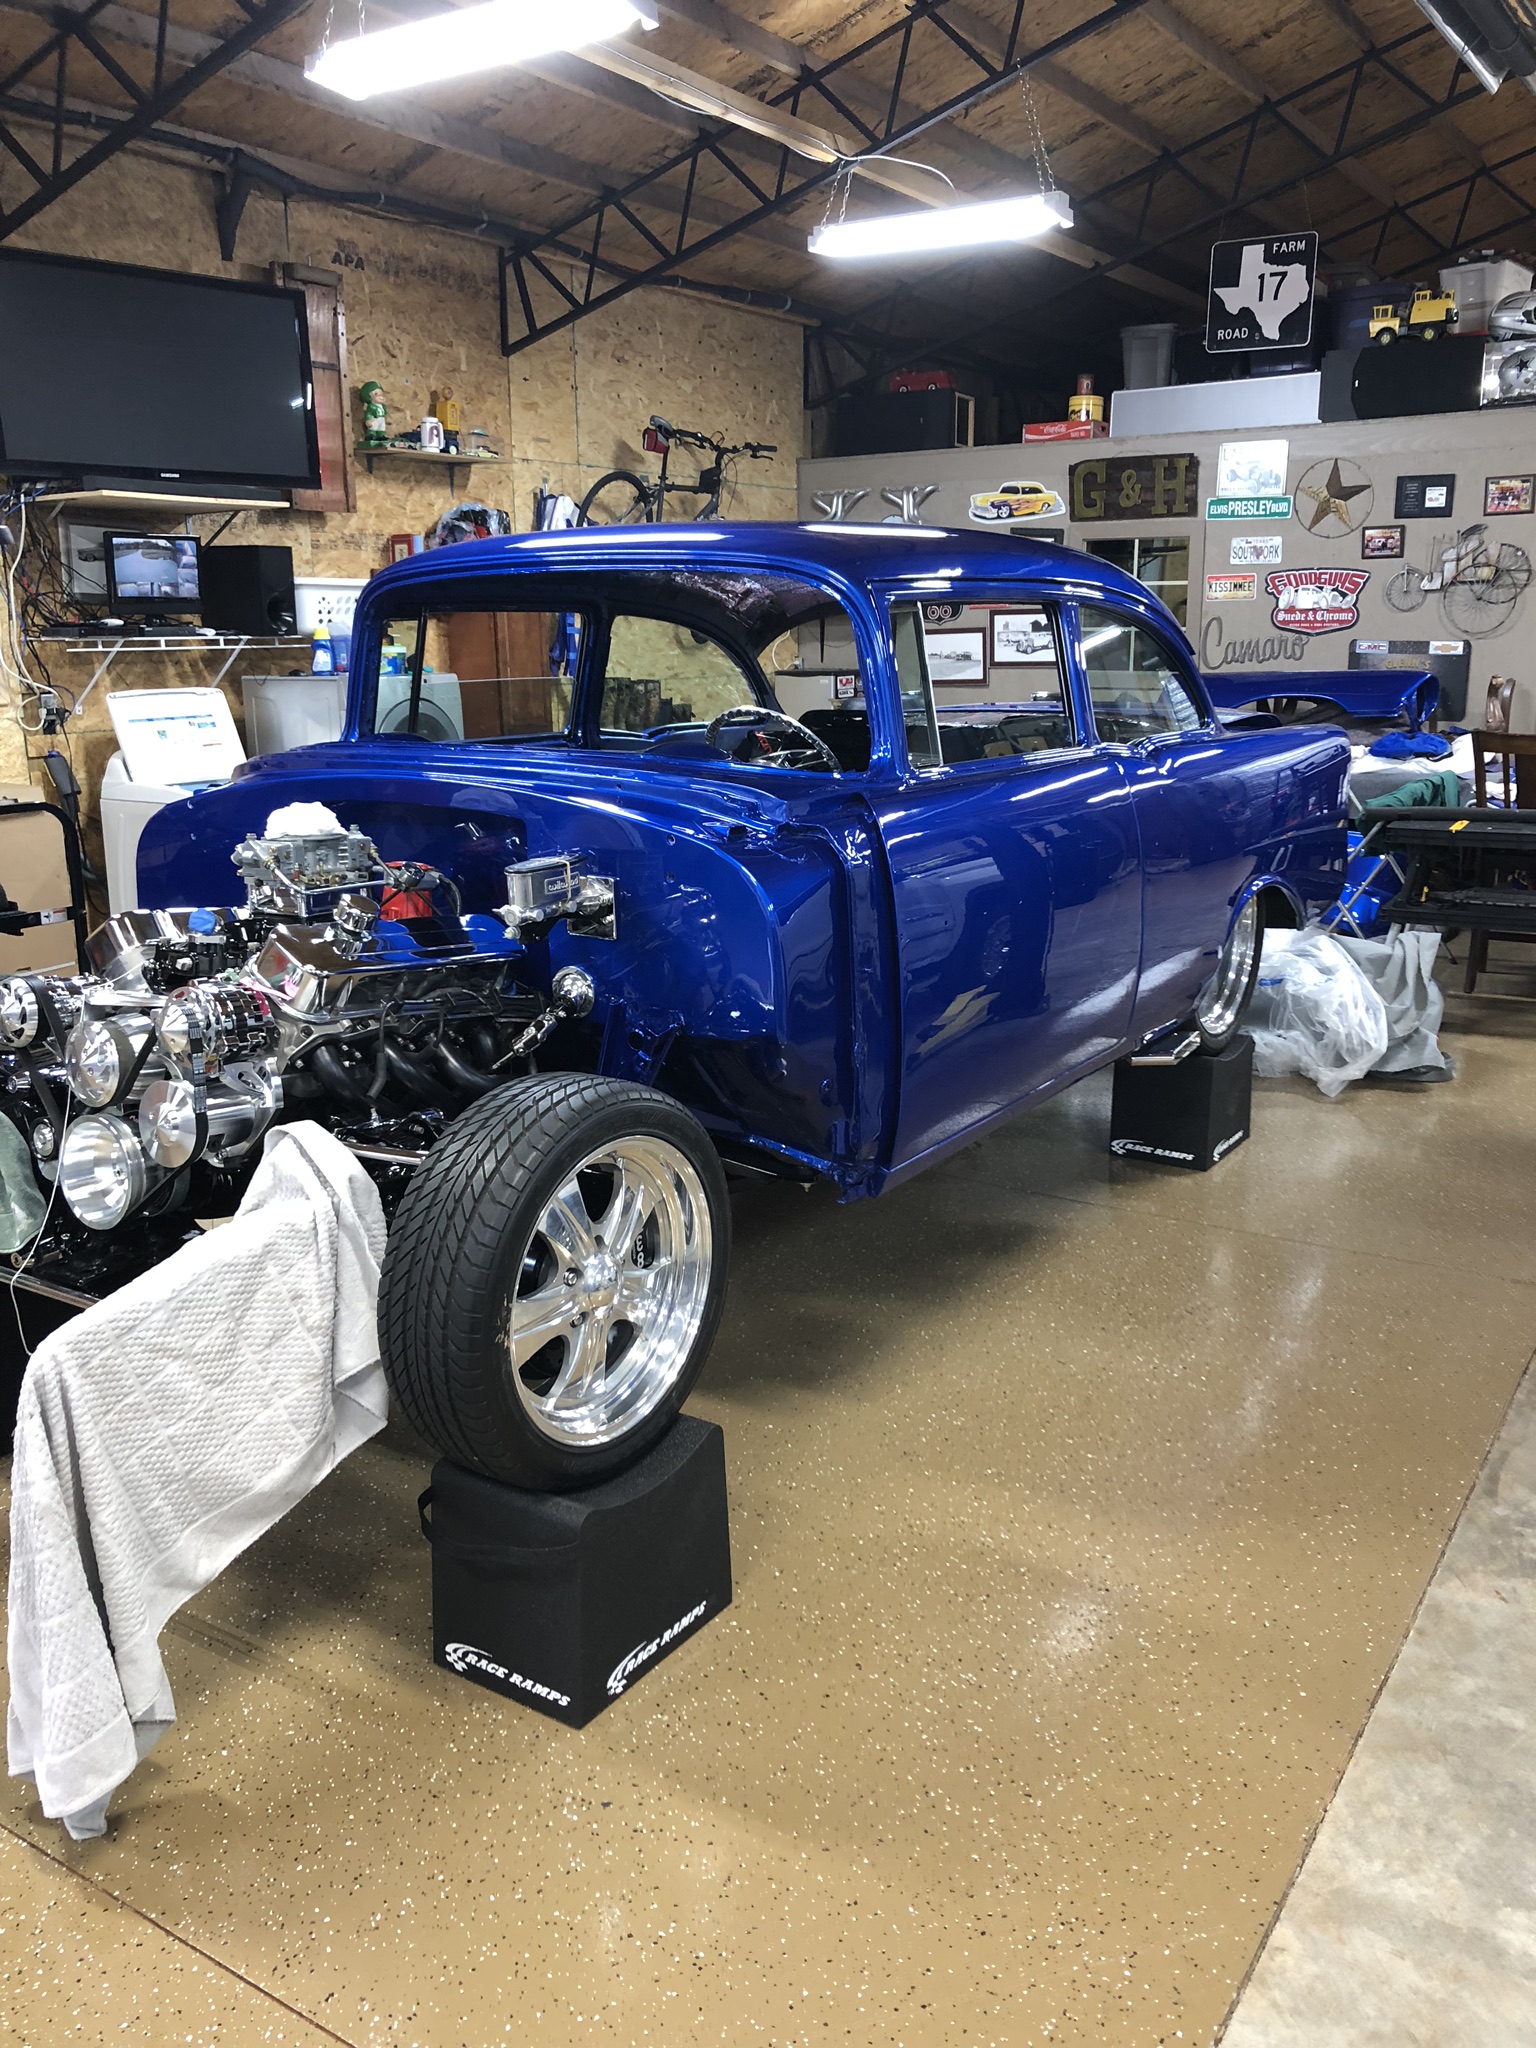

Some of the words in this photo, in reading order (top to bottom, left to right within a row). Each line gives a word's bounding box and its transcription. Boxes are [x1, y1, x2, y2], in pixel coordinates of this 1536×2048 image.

[1272, 240, 1306, 254] FARM
[331, 251, 366, 271] APA
[1258, 271, 1288, 302] 17
[1217, 327, 1249, 340] ROAD
[1074, 461, 1106, 518] G
[1119, 469, 1141, 508] &
[1151, 457, 1189, 514] H
[1210, 505, 1228, 514] ELVIS
[1228, 500, 1273, 515] PRESLEY
[1232, 545, 1280, 560] SOUTORK
[1208, 580, 1253, 592] KISSIMMEE
[1268, 571, 1368, 597] GOODGUYS
[1277, 610, 1306, 621] Suede
[1307, 610, 1314, 621] &
[1316, 610, 1353, 622] Chrome
[1201, 616, 1310, 670] Camaro
[1358, 642, 1387, 651] GMC
[548, 876, 579, 891] wilwod
[1124, 1143, 1154, 1153] RACE
[1153, 1148, 1195, 1160] RAMPS
[624, 1637, 660, 1677] RACE
[660, 1600, 707, 1647] RAMPS
[464, 1653, 509, 1679] RACE
[509, 1672, 571, 1707] RAMPS
